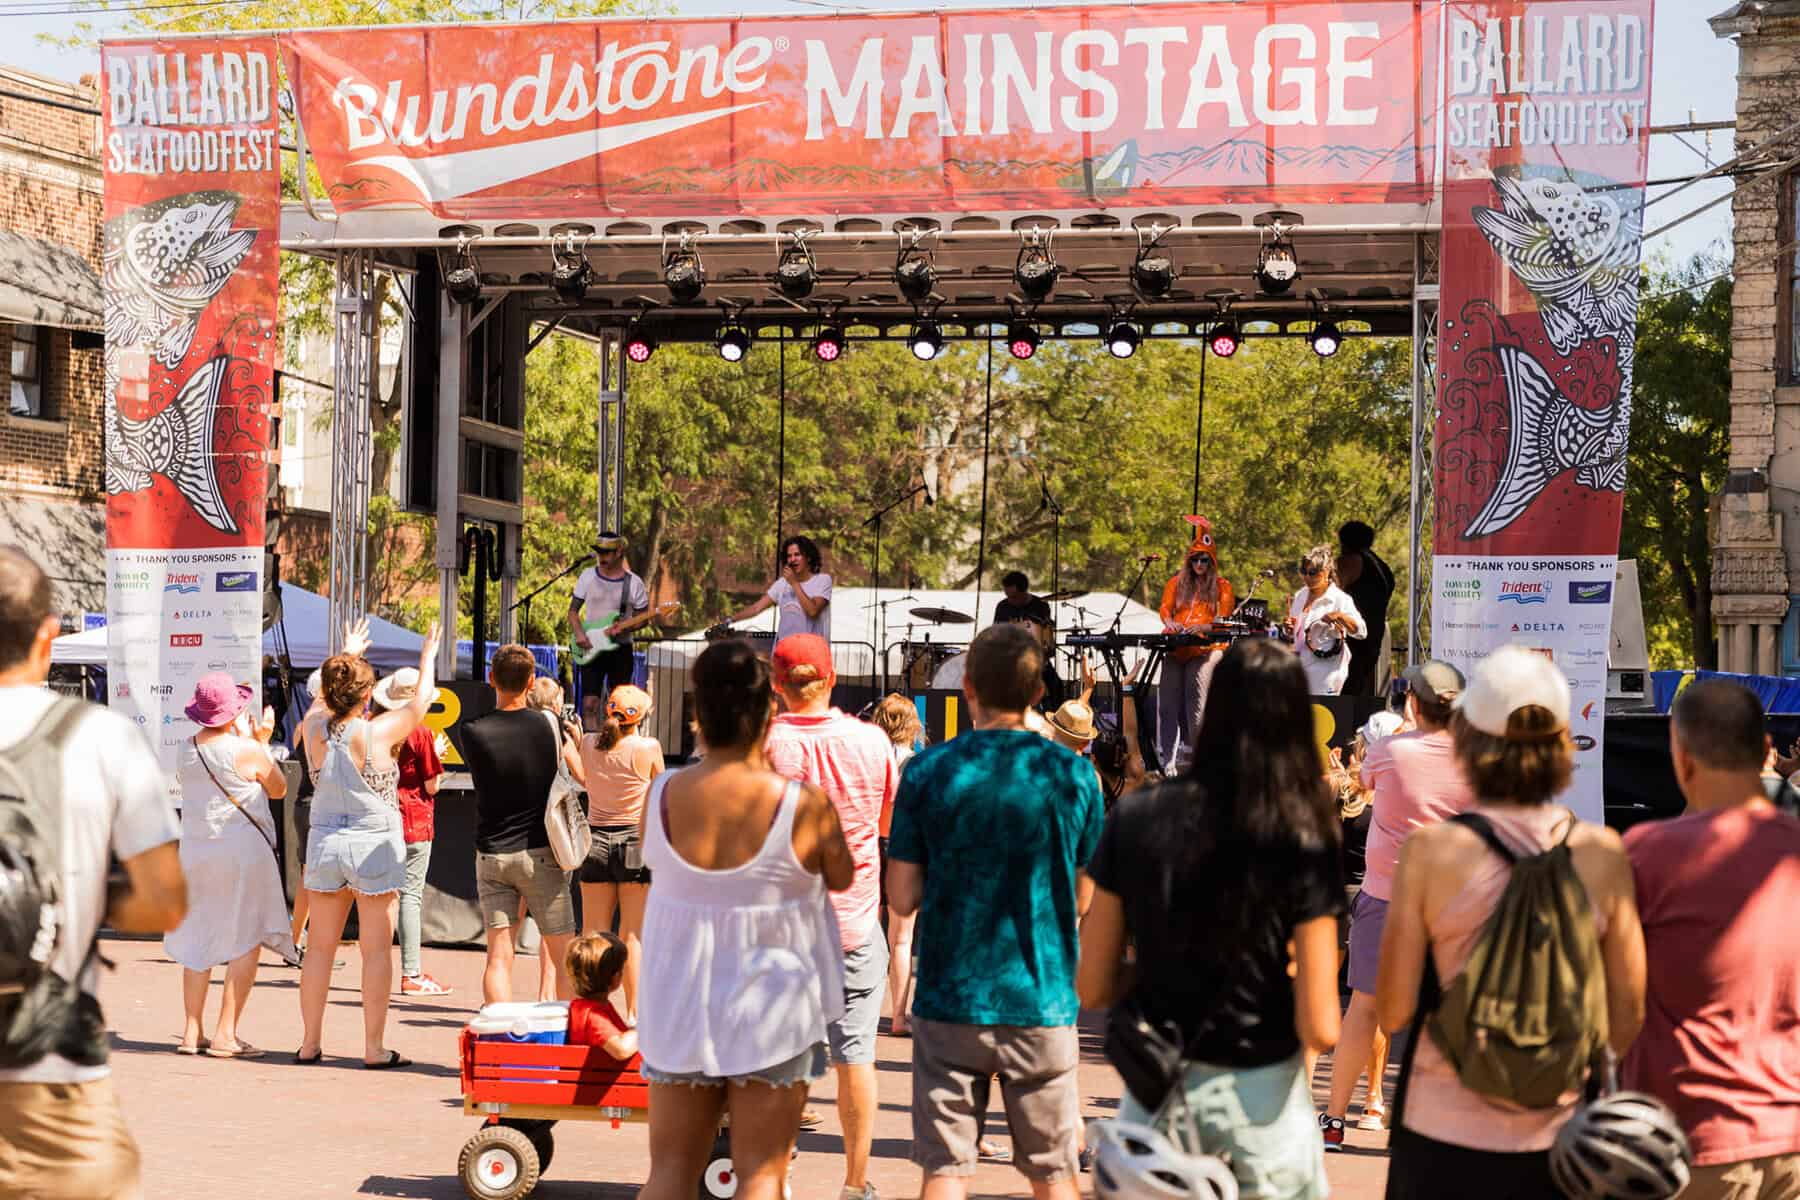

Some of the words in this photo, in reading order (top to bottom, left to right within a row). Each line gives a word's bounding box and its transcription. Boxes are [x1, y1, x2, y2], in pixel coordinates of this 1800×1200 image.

[1451, 13, 1644, 95] BALLARD
[804, 22, 1381, 140] MAINSTAGE
[108, 51, 271, 126] BALLARD
[1449, 98, 1648, 147] SEAFOODFEST
[108, 128, 275, 174] SEAFOODFEST
[136, 555, 168, 563] THANK
[171, 555, 190, 563] YOU
[192, 553, 237, 563] SPONSORS
[1467, 561, 1504, 570] THANK
[1507, 561, 1529, 571] YOU
[1531, 561, 1595, 571] SPONSORS
[167, 573, 199, 583] Trident
[1501, 581, 1543, 592] Trident
[1442, 591, 1481, 600] country
[182, 610, 212, 618] DELTA
[1524, 623, 1565, 631] DELTA
[150, 684, 174, 694] MiiR
